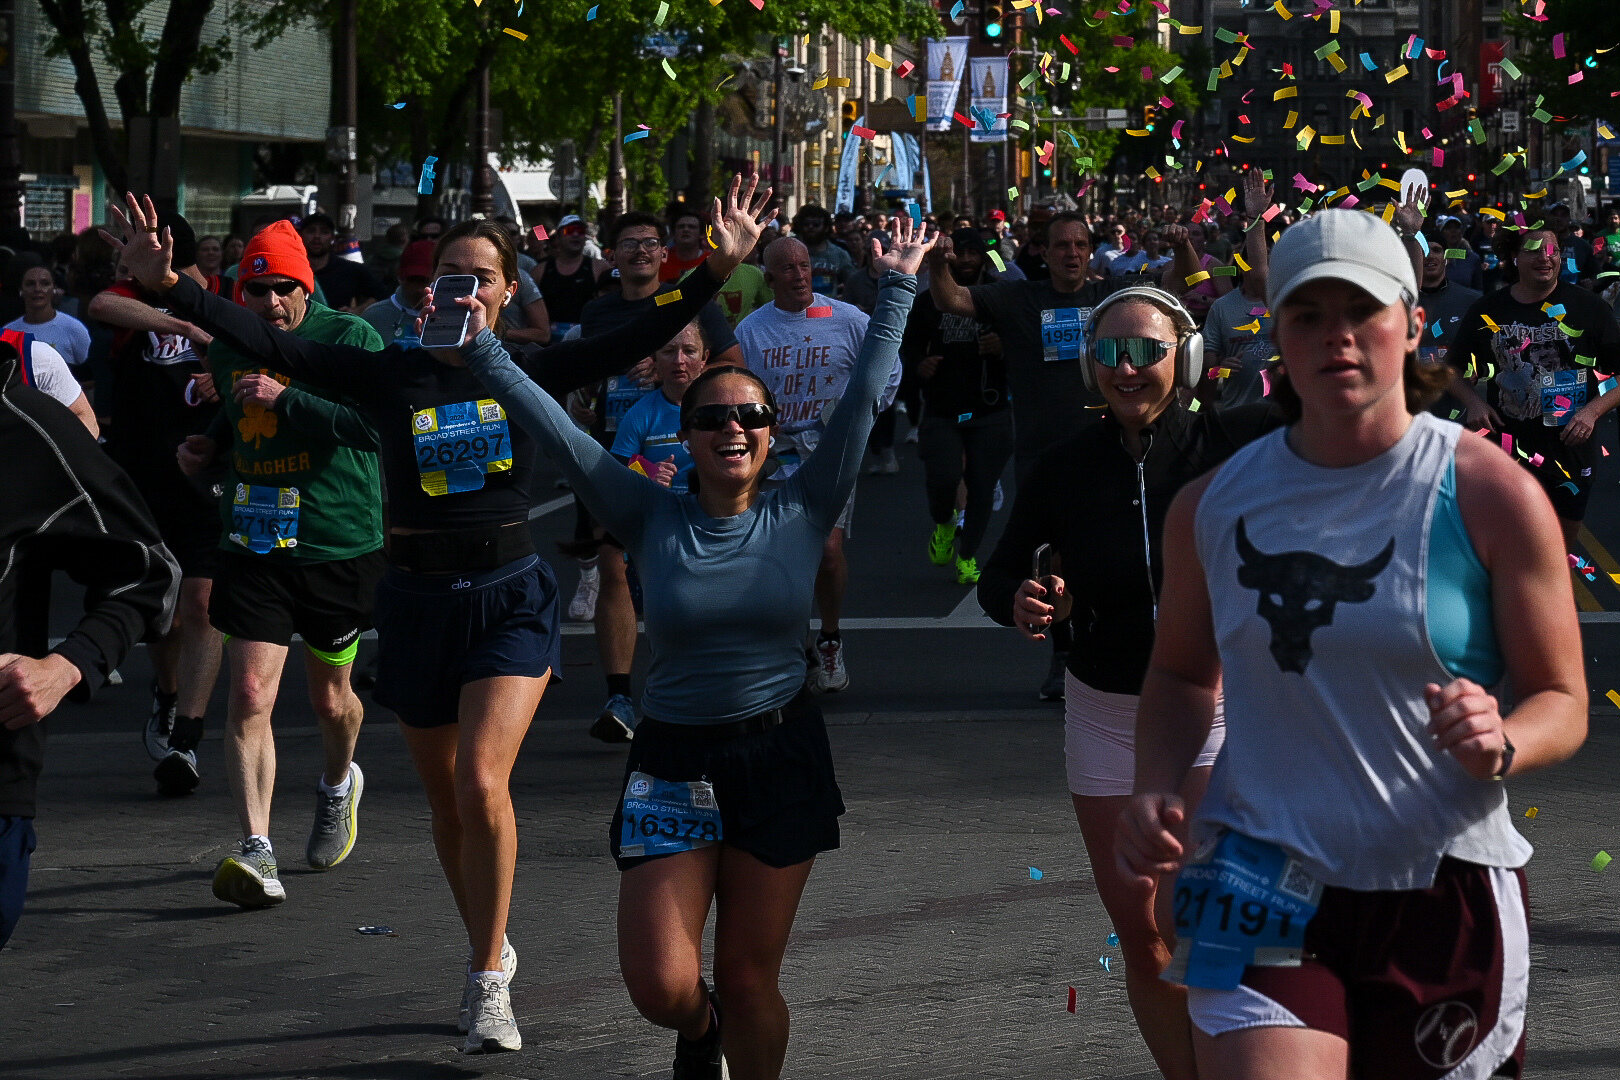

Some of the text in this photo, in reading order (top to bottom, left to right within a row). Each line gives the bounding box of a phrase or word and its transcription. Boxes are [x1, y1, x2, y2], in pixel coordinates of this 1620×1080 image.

[1044, 328, 1081, 344] 1957
[762, 345, 831, 370] THE LIFE
[783, 373, 817, 397] OF A
[777, 398, 832, 425] UNNE
[418, 423, 501, 443] BROAD STREET RUN
[418, 433, 505, 468] 26297
[234, 505, 255, 513] BROAD
[255, 507, 278, 515] STREET
[451, 578, 472, 590] alo
[626, 801, 659, 811] BROAD
[626, 812, 719, 841] 16378
[1219, 869, 1270, 900] STREET
